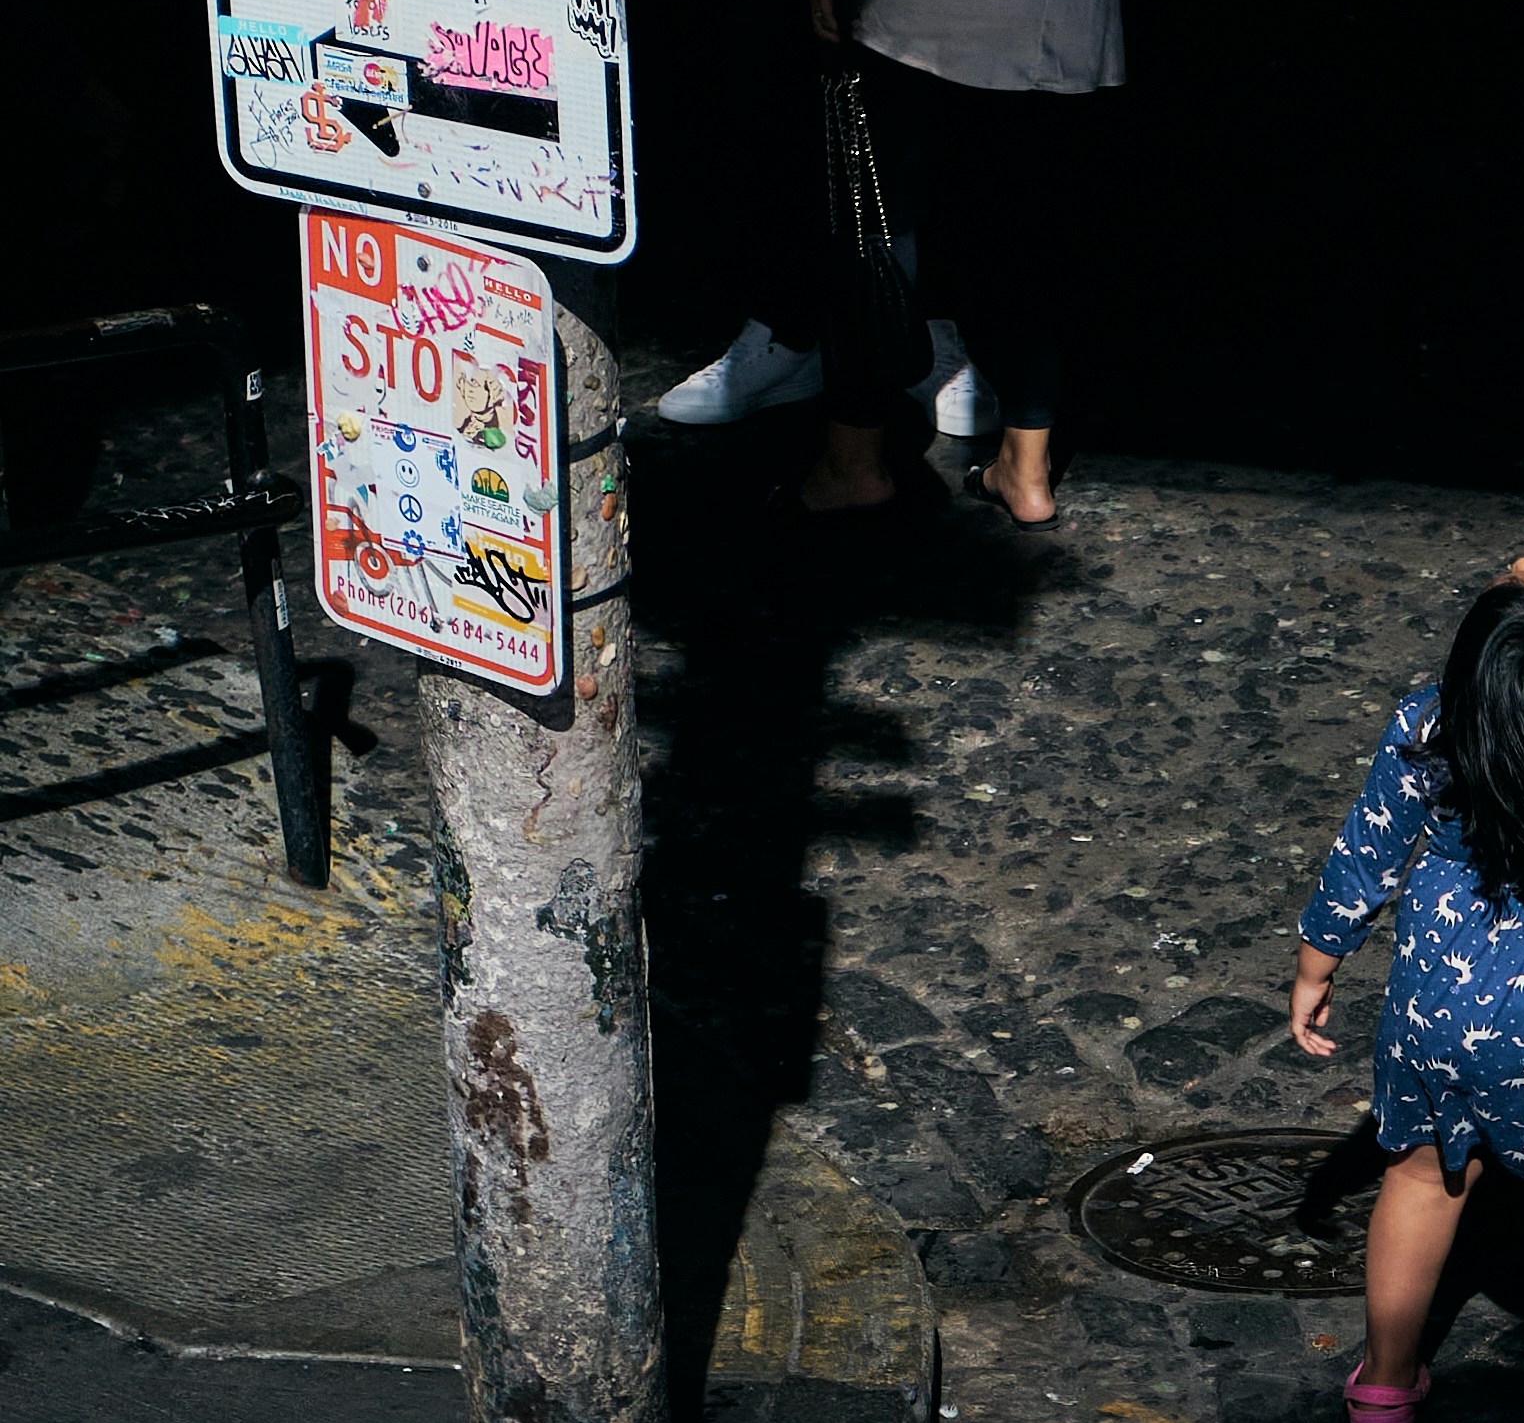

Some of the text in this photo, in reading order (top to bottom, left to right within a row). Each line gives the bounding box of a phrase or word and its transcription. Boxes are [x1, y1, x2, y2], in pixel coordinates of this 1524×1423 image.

[238, 21, 288, 37] HELLO
[321, 219, 382, 287] NO
[484, 277, 532, 303] HELLO
[461, 490, 521, 519] MAKE SEATTLE
[463, 502, 490, 519] SHITTY
